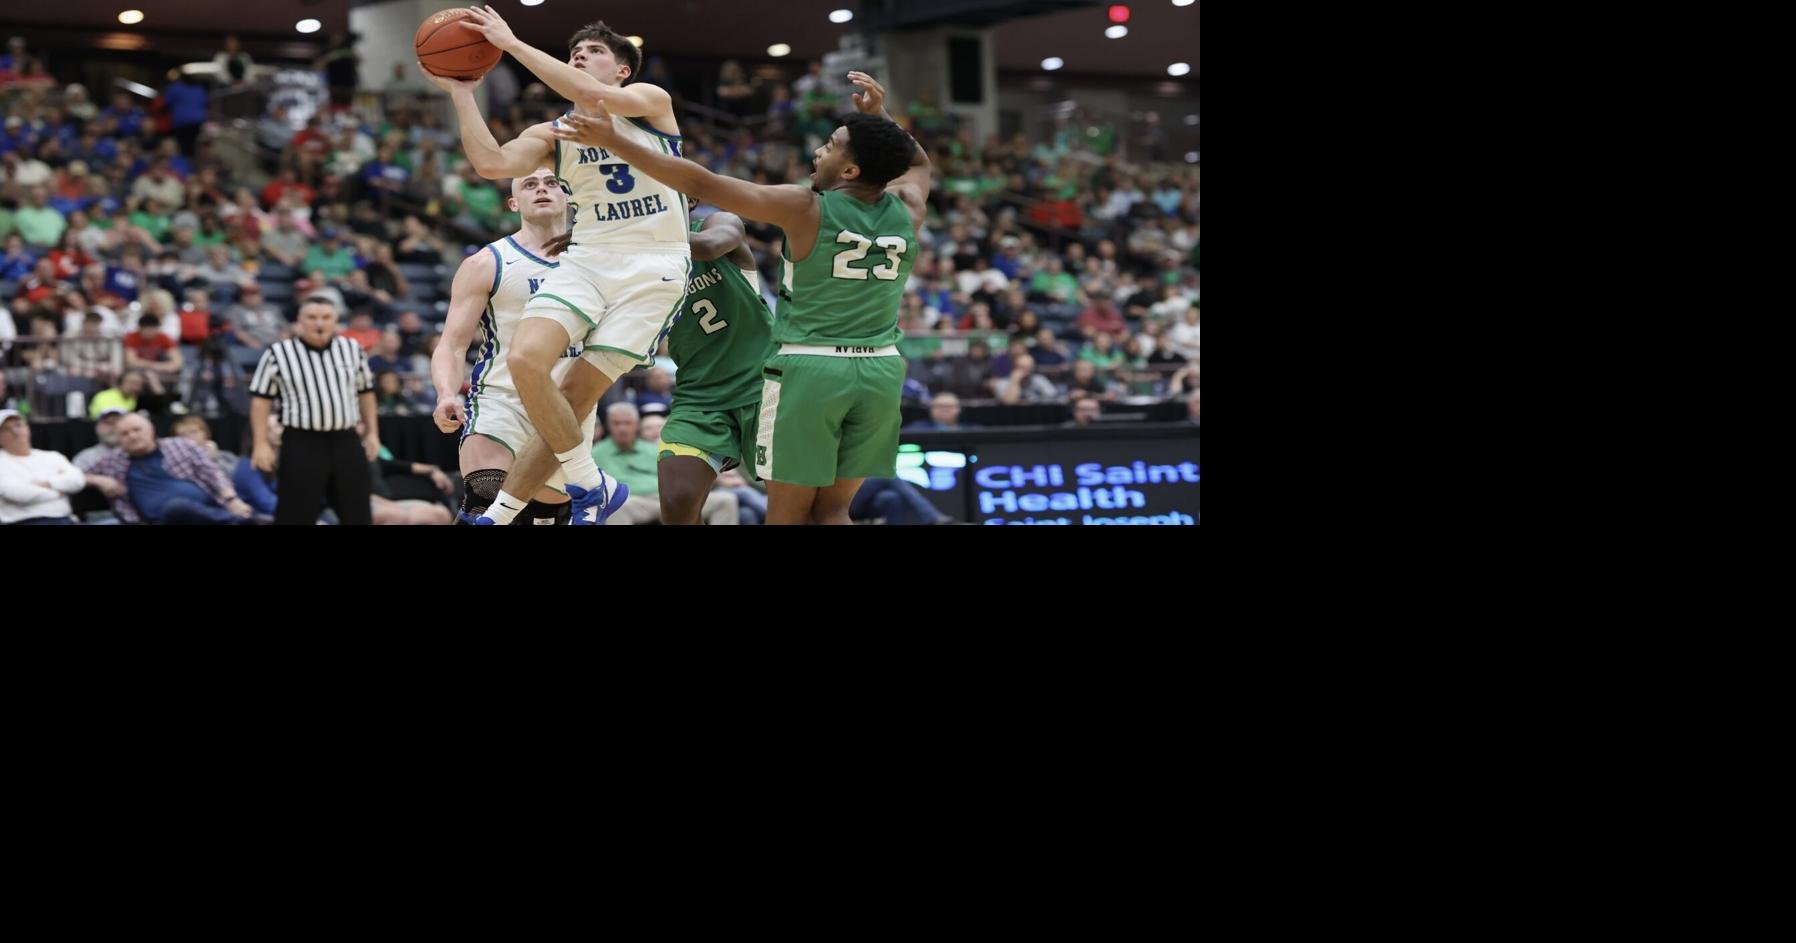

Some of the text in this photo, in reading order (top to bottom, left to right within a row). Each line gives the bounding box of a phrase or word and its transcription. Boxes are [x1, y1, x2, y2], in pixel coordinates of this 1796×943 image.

[576, 145, 616, 164] NOR
[599, 163, 635, 194] 3
[594, 194, 668, 221] LAUREL
[832, 230, 907, 281] 23
[686, 267, 722, 296] GONS
[691, 298, 729, 335] 2
[975, 461, 1200, 489] CHI Saint
[979, 485, 1146, 513] Health
